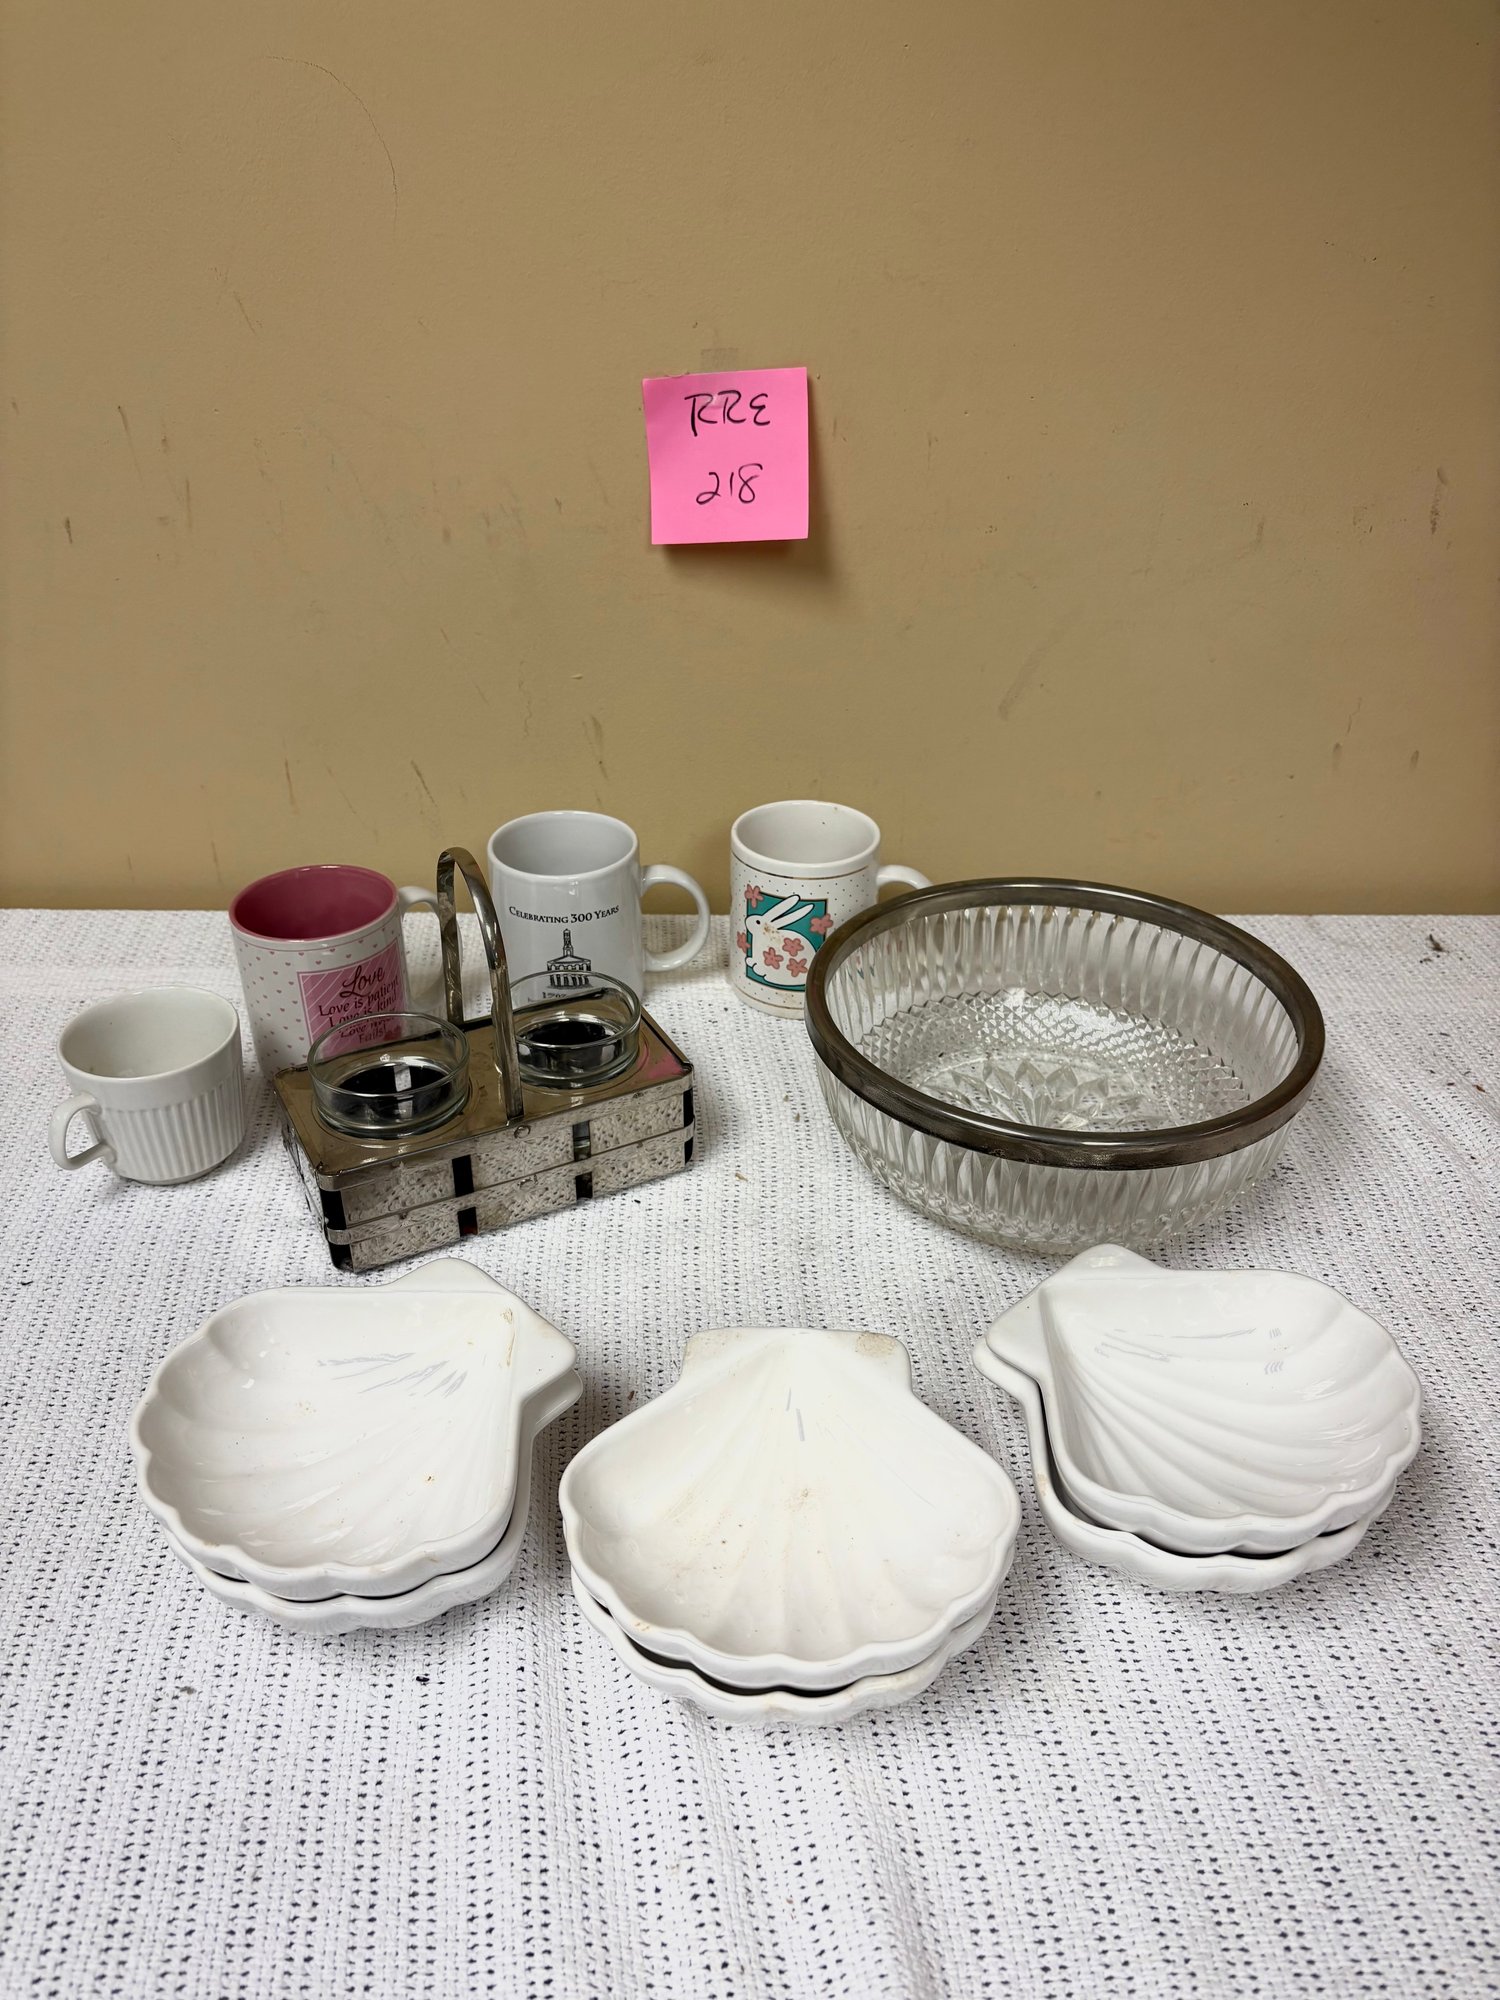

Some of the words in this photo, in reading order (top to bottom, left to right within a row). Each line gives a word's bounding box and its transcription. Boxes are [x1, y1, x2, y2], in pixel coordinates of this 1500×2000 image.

[696, 463, 763, 505] 218
[570, 912, 592, 923] 300
[339, 965, 386, 998] Love
[319, 1003, 350, 1017] Love
[354, 997, 364, 1009] is
